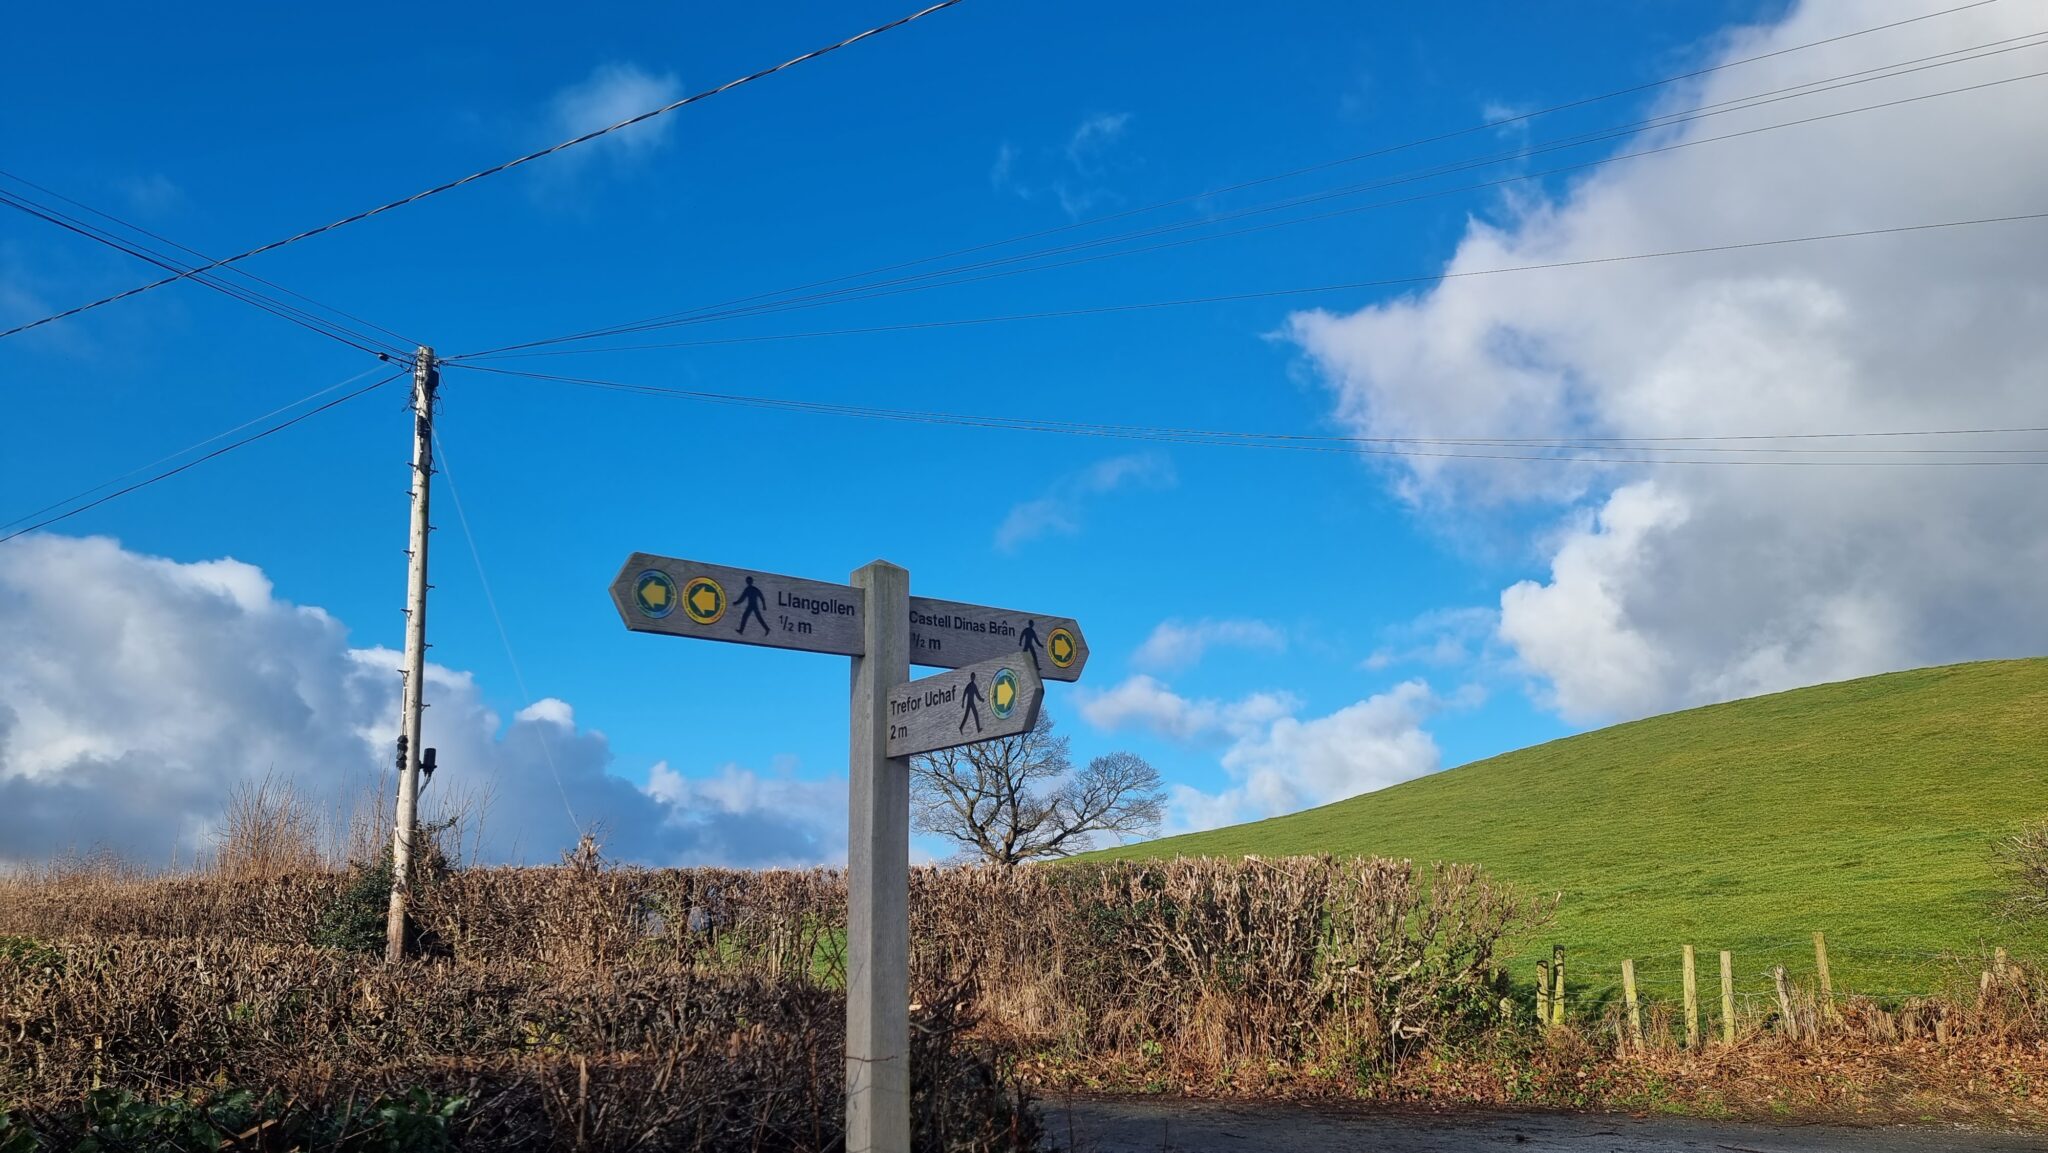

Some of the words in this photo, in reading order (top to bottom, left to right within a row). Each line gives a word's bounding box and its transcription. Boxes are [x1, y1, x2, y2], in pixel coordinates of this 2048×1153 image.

[778, 591, 855, 616] Llangollen
[798, 621, 812, 634] m
[909, 610, 951, 629] Castell
[954, 616, 986, 633] Dinas
[989, 620, 1016, 637] Brân
[928, 638, 941, 650] m
[890, 696, 922, 716] Trefor
[924, 685, 957, 707] Uchaf
[890, 725, 897, 740] 2
[898, 724, 908, 738] m
